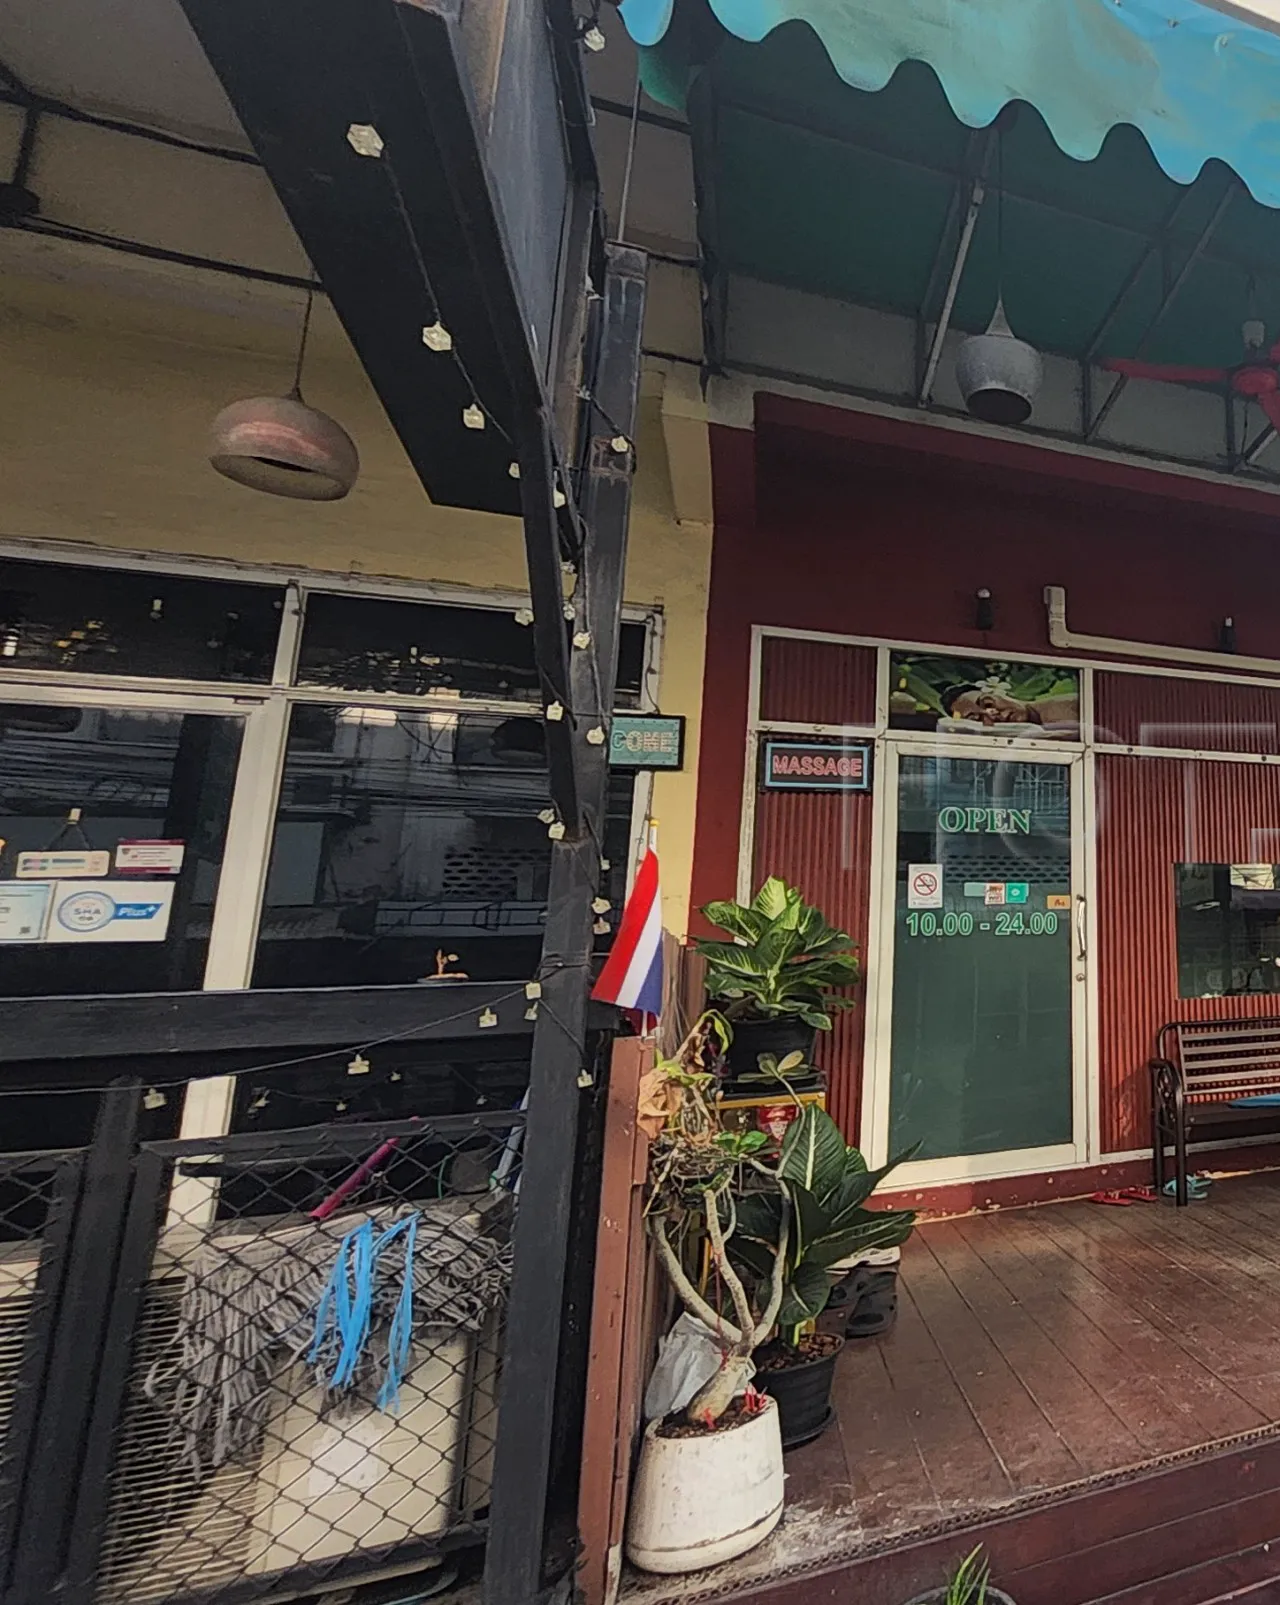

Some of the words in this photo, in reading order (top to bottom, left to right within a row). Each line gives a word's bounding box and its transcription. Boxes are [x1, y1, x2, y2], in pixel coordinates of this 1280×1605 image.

[772, 754, 862, 777] MASSAGE
[939, 806, 1032, 834] OPEN
[906, 912, 973, 936] 10.00
[995, 911, 1058, 936] 24.00
